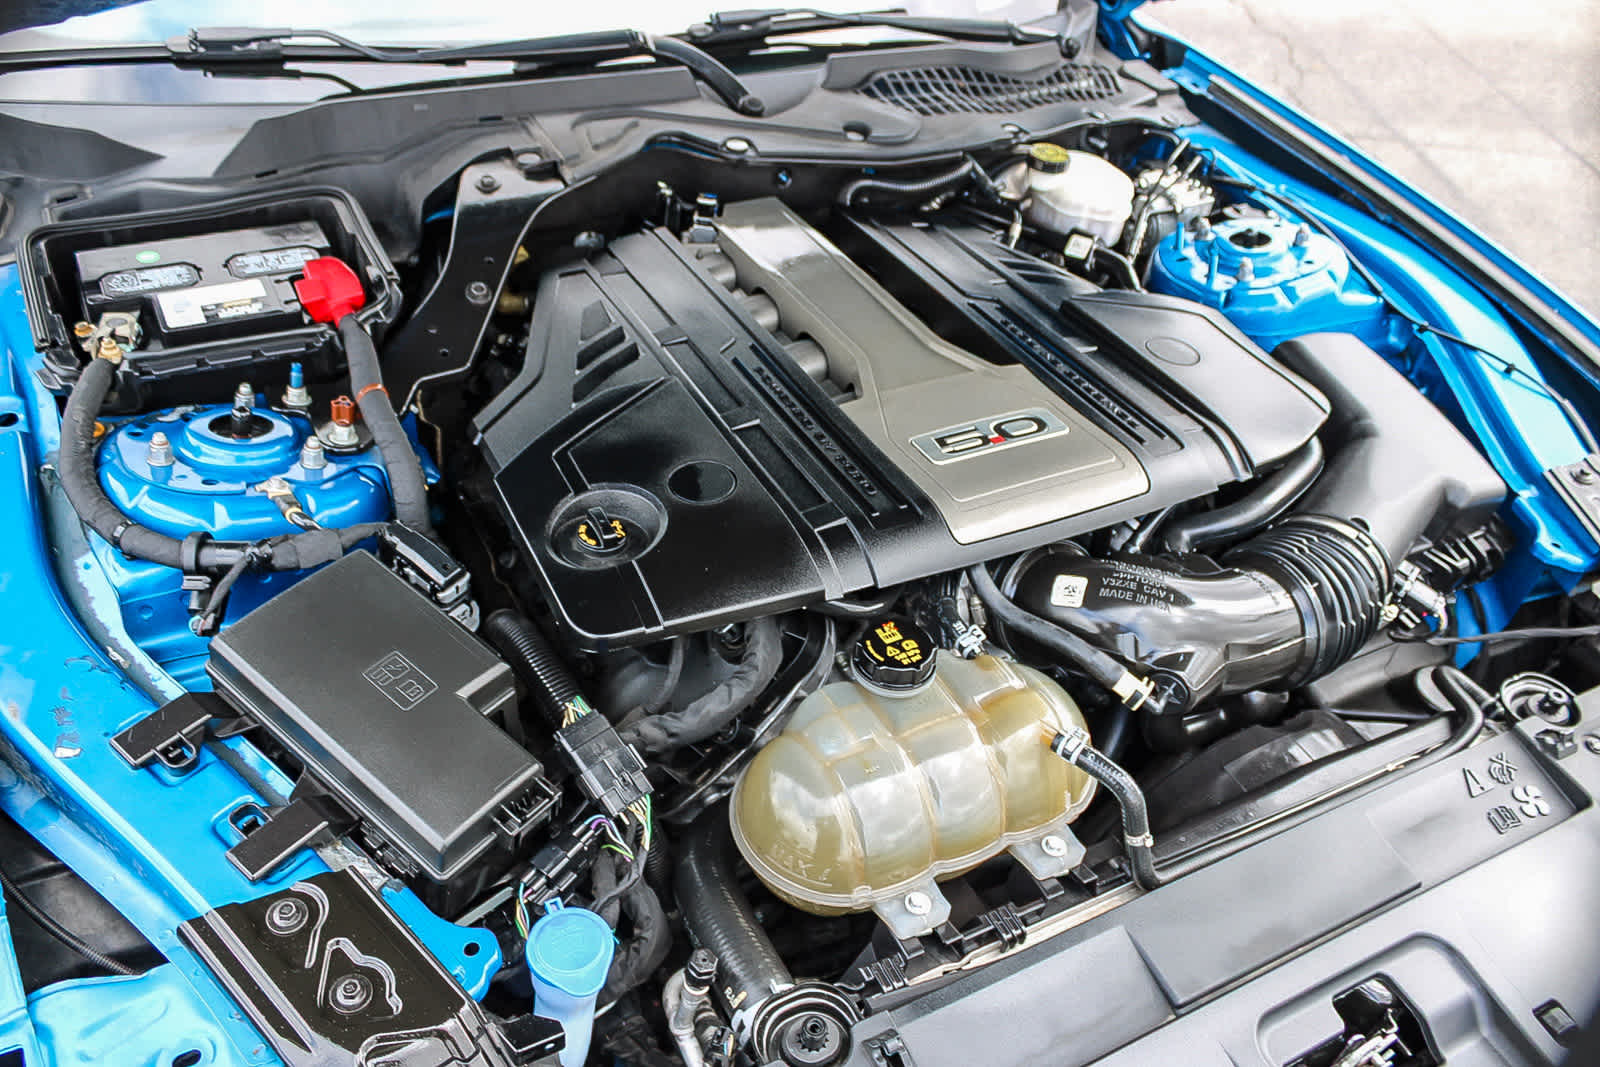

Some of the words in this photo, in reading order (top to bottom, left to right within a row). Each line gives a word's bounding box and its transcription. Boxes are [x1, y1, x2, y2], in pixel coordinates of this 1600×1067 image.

[934, 416, 1048, 454] 5.0
[1098, 587, 1134, 602] MADE
[1135, 593, 1149, 605] IN
